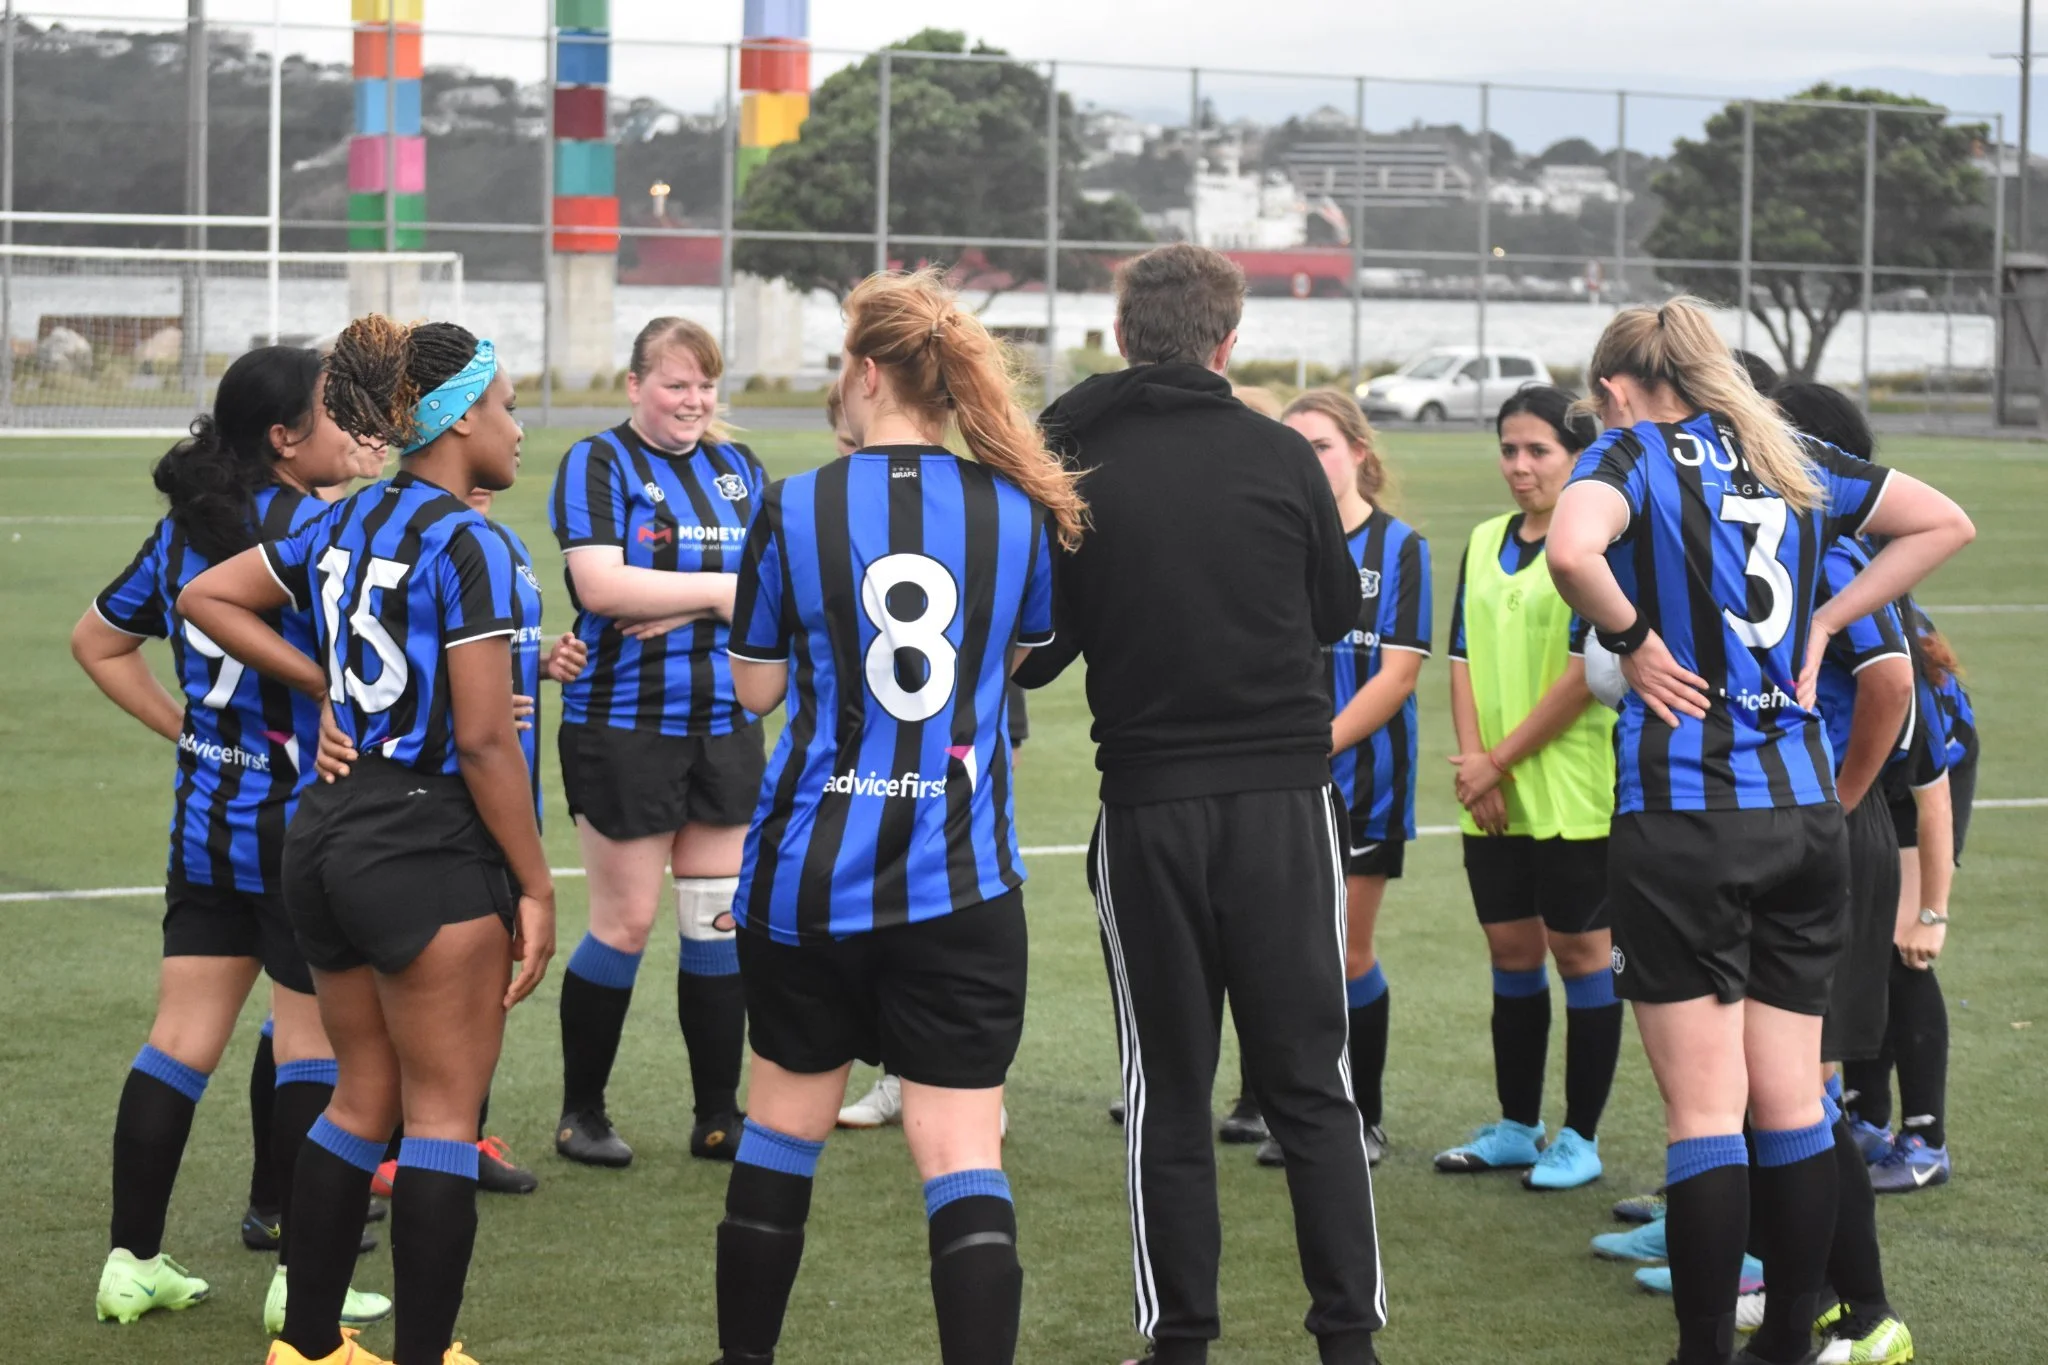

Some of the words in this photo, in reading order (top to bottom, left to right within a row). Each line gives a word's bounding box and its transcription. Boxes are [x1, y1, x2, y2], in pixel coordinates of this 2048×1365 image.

[1724, 481, 1768, 495] LEGA
[316, 545, 411, 714] 15
[862, 553, 958, 722] 8
[1720, 494, 1793, 649] 3
[823, 768, 947, 799] advicefirst
